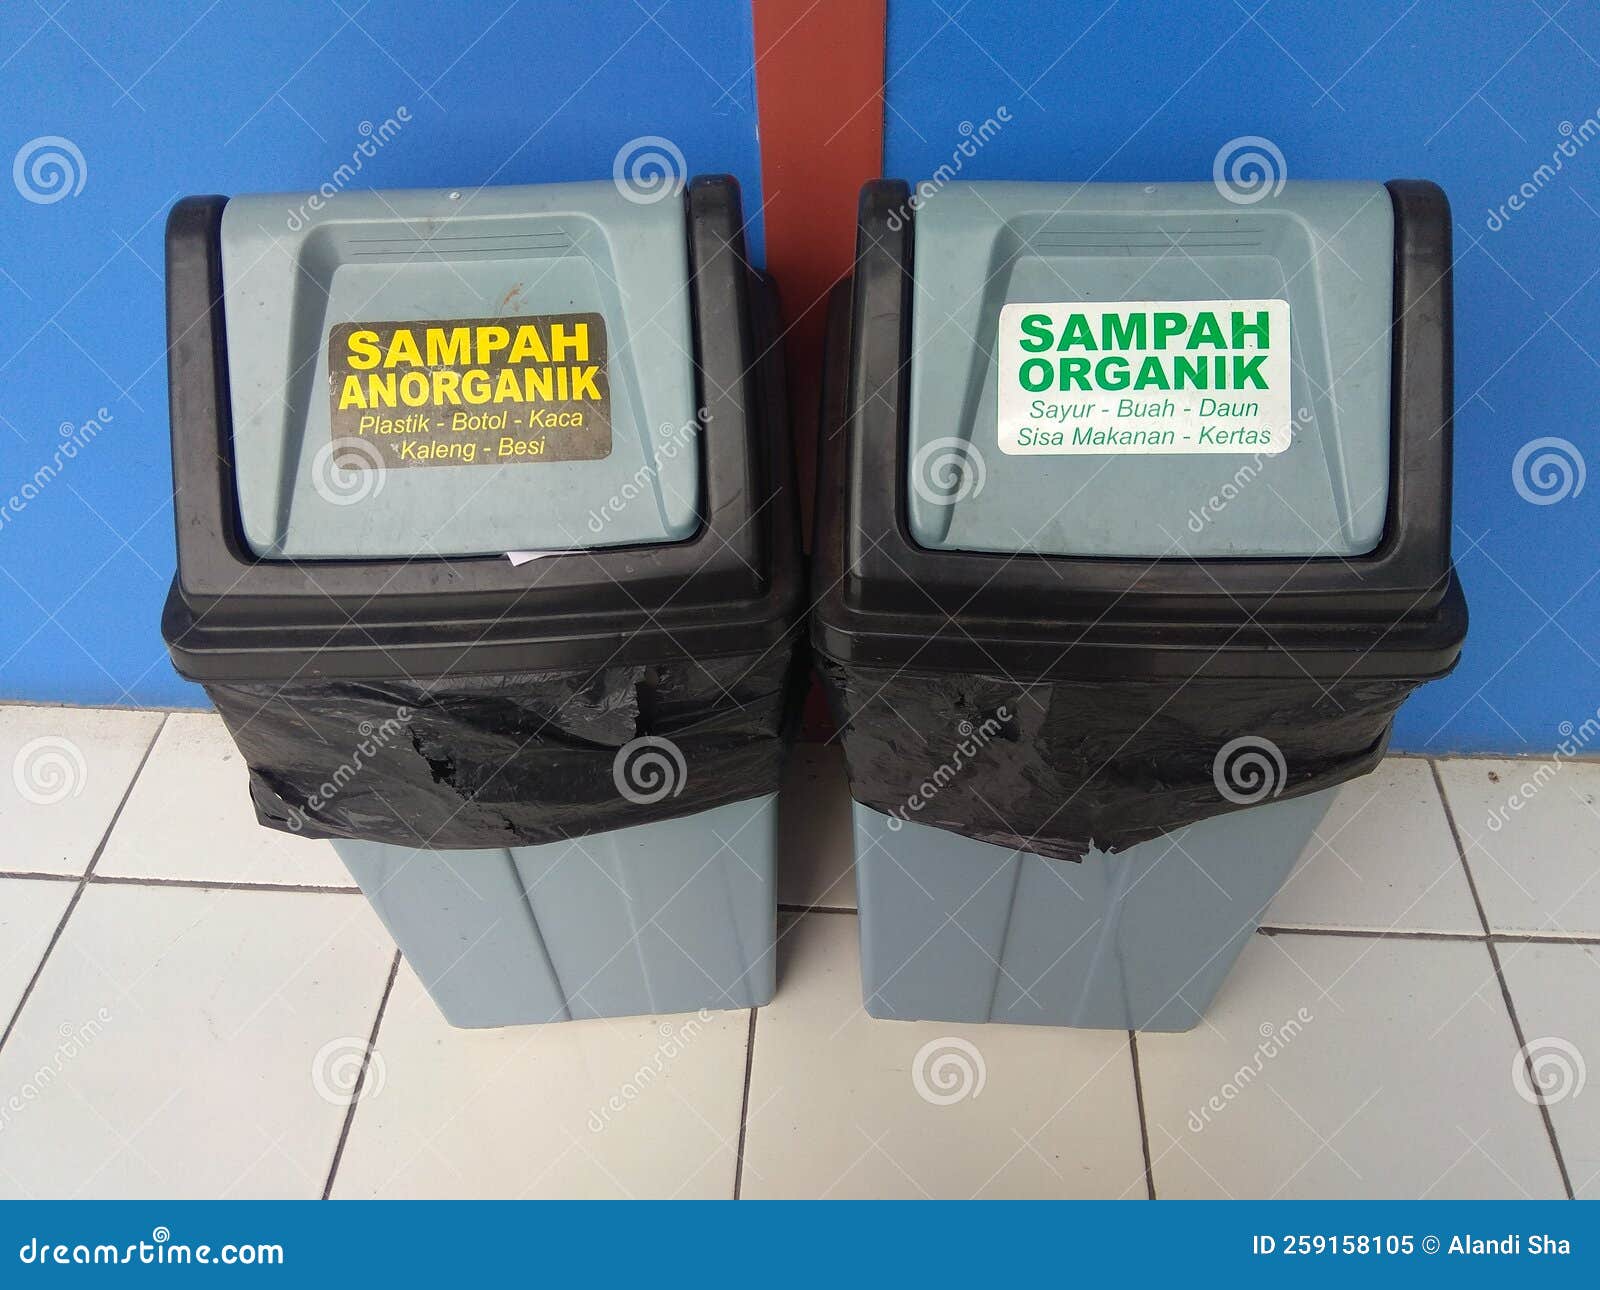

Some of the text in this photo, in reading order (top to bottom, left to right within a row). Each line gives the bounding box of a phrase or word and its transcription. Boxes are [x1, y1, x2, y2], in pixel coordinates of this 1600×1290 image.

[347, 323, 589, 370] SAMPAH
[1019, 311, 1270, 353] SAMPAH
[338, 366, 602, 410] ANORGANIK
[1018, 355, 1269, 393] ORGANIK
[359, 413, 430, 435] Plastik
[451, 411, 507, 432] Botol
[528, 409, 583, 429] Kaca
[1029, 400, 1096, 423] Sayur
[1117, 399, 1175, 418] Buah
[1199, 398, 1258, 417] Daun
[400, 440, 476, 462] Kaleng
[498, 436, 545, 456] Besi
[1017, 427, 1063, 446] Sisa
[1072, 427, 1174, 446] Makanan
[1198, 426, 1271, 446] Kertas
